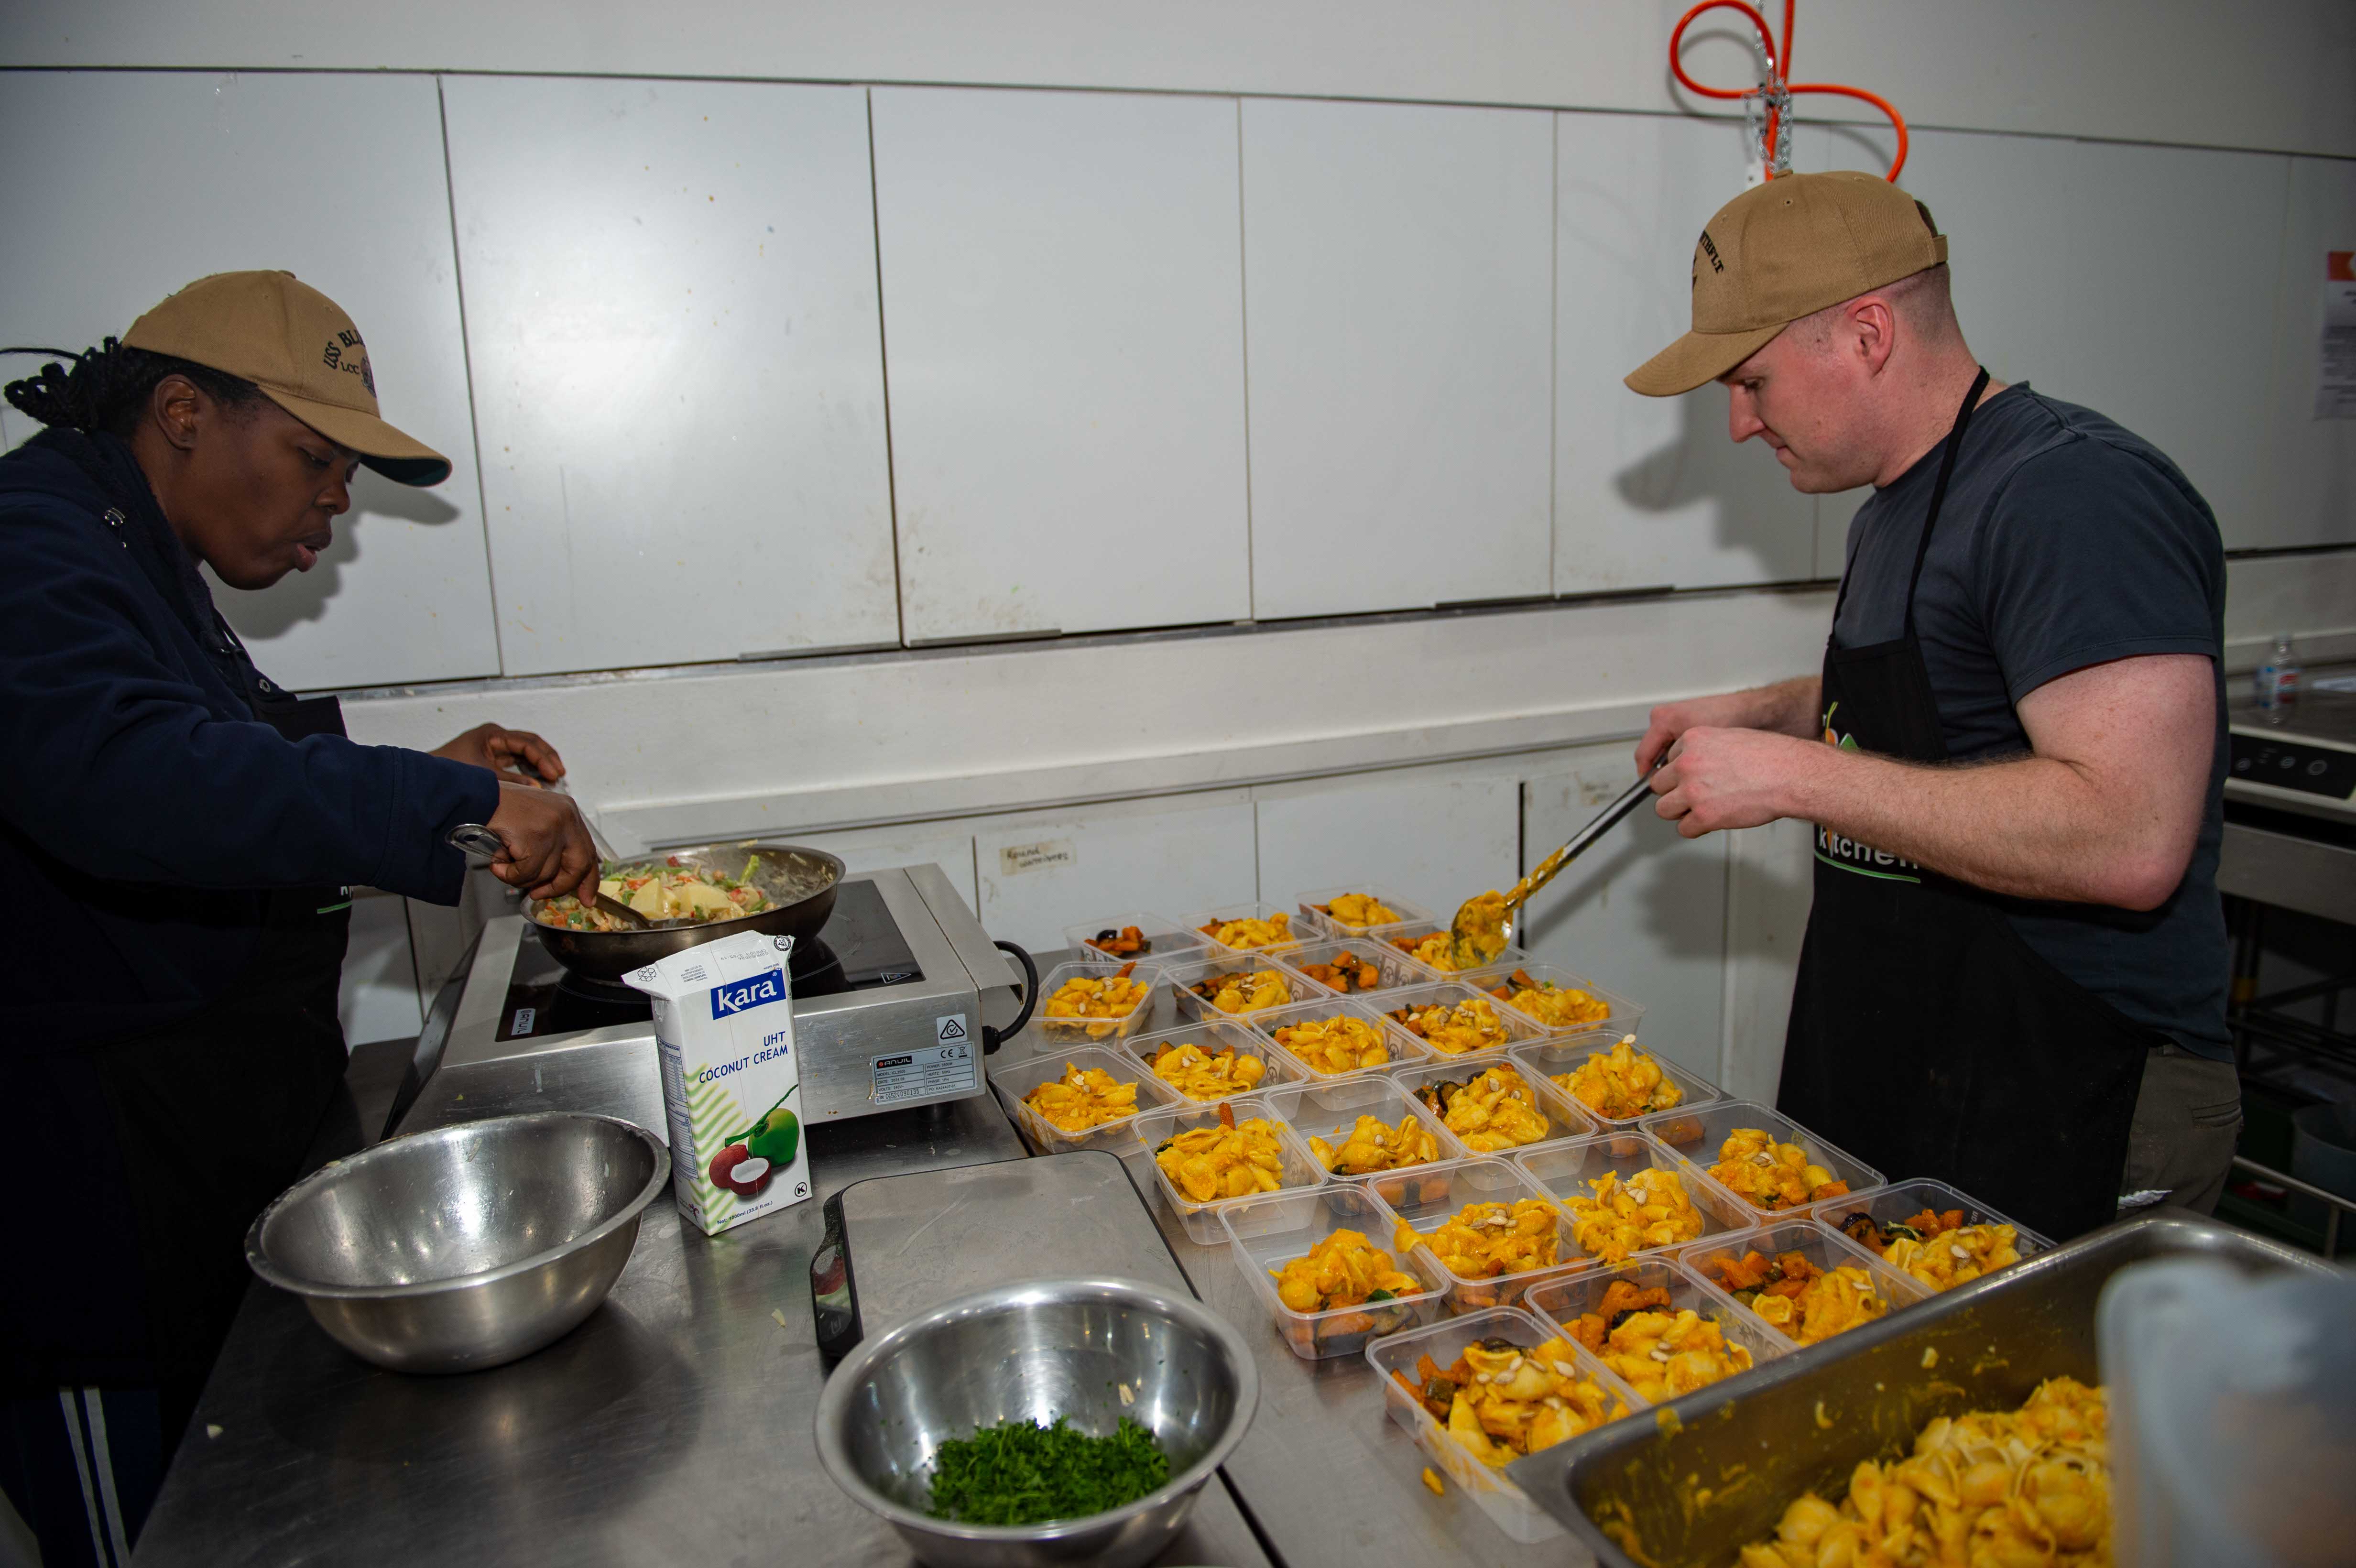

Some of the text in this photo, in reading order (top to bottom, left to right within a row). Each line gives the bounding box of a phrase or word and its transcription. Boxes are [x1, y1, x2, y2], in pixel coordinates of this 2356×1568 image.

[324, 341, 341, 370] USS
[340, 361, 360, 374] LCC
[718, 980, 777, 1012] kara
[764, 1031, 785, 1046] UHT
[699, 1044, 788, 1083] COCONUT CREAM
[729, 1211, 746, 1220] 1000ml
[747, 1206, 758, 1214] (33.8
